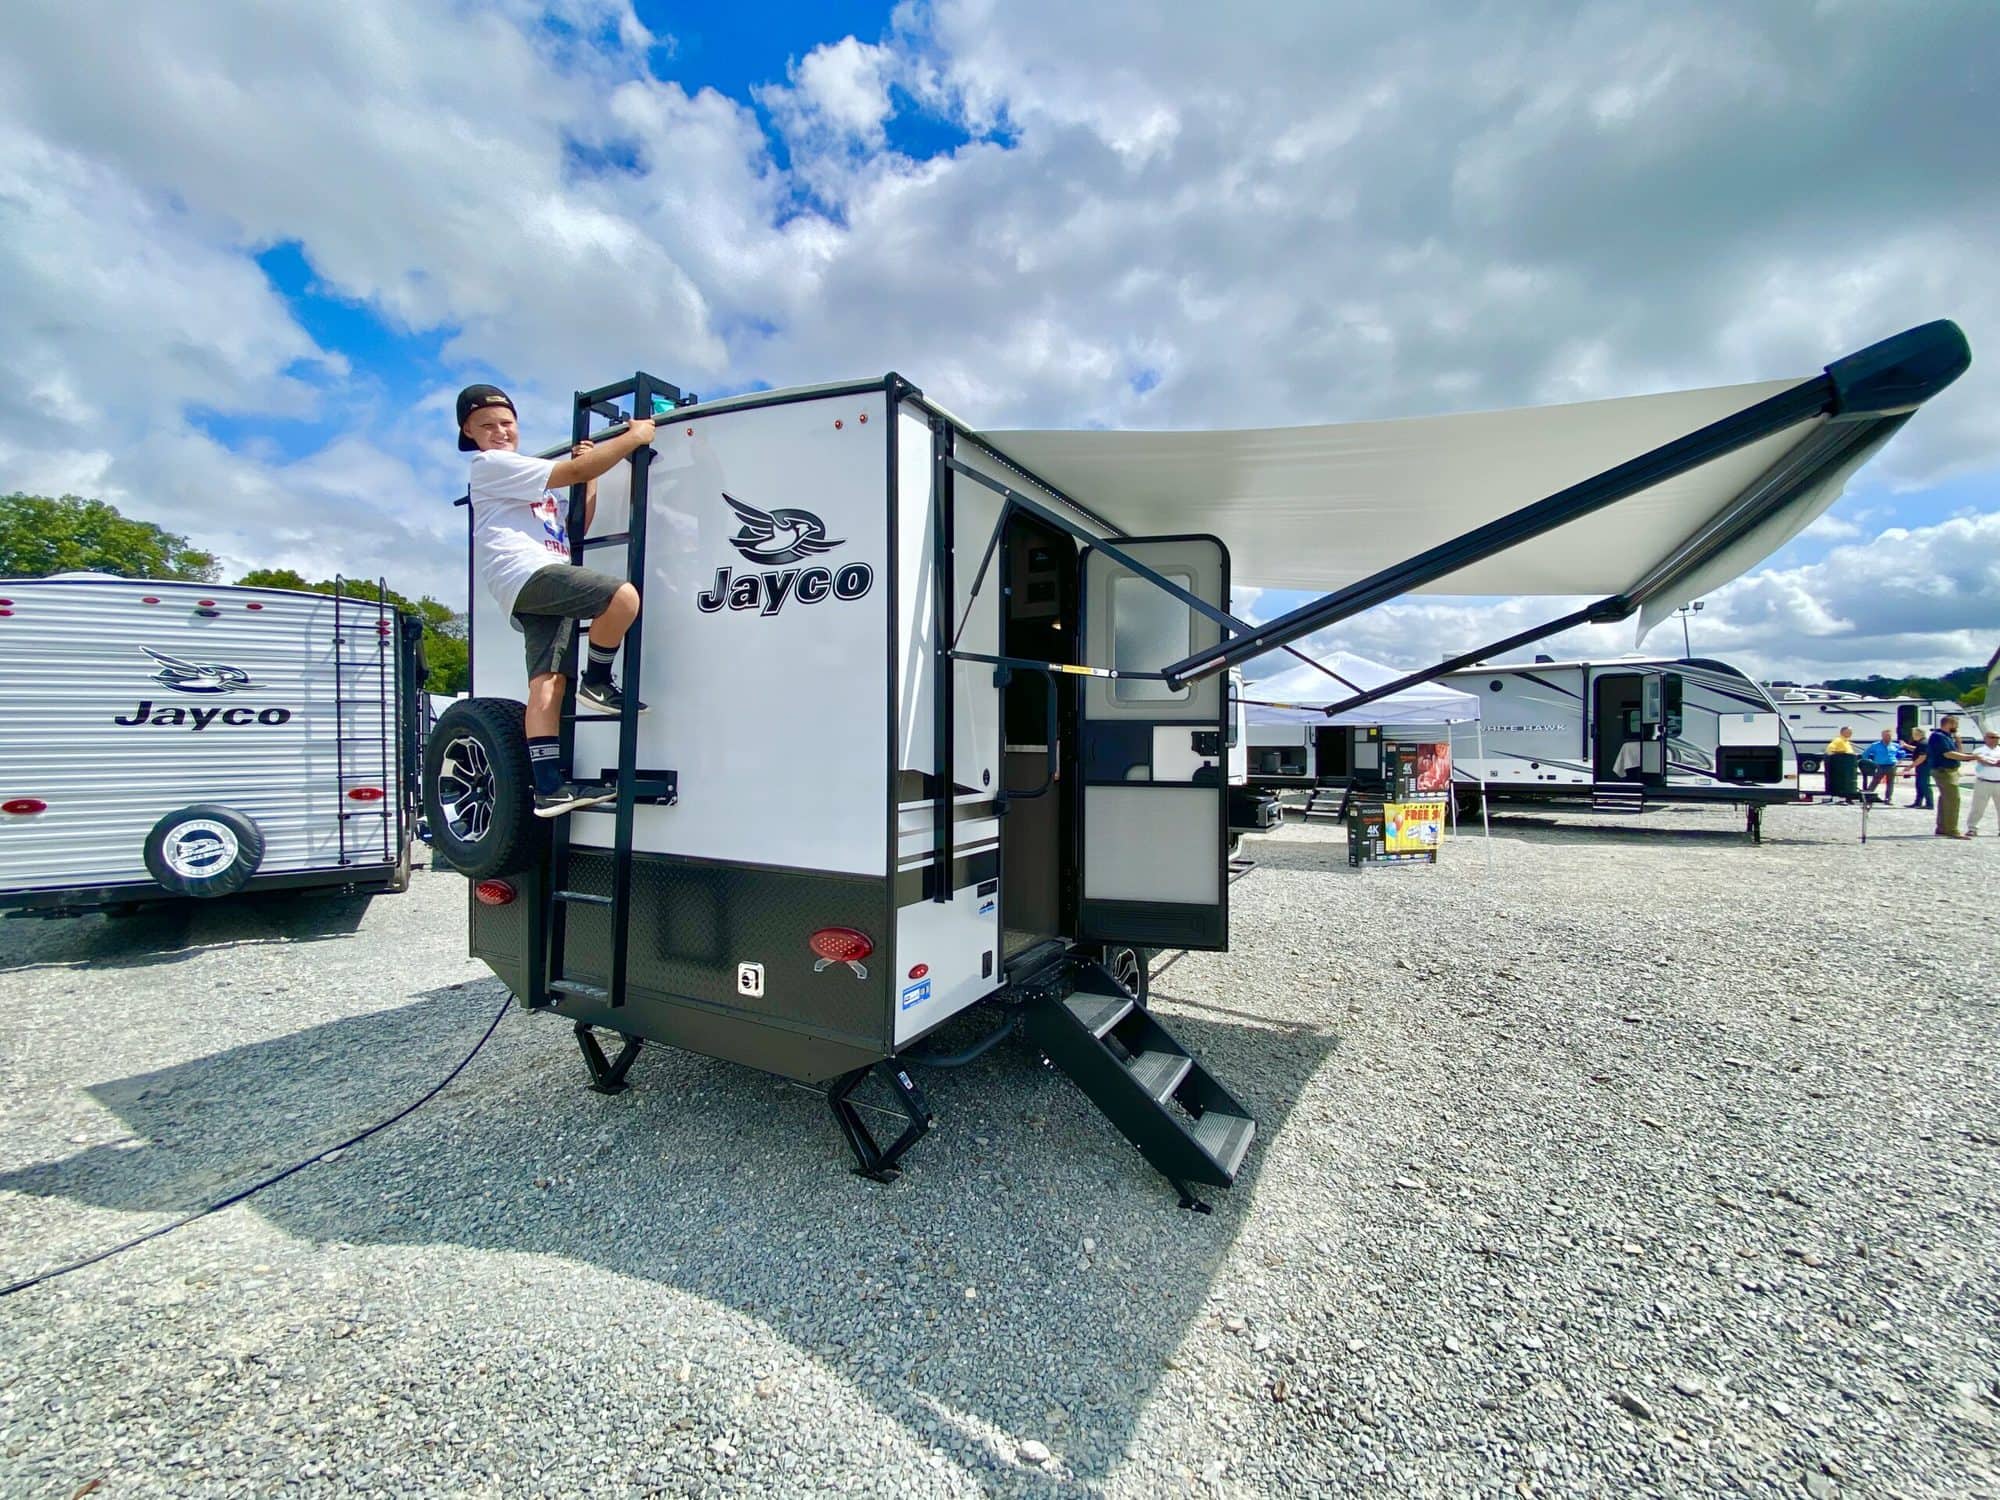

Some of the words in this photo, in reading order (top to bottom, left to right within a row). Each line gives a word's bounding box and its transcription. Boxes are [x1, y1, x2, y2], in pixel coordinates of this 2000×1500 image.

[697, 562, 873, 617] Jayco
[114, 701, 291, 731] Jayco
[1523, 723, 1565, 733] HAWK
[1404, 809, 1430, 820] FREE
[1367, 824, 1380, 834] 4K
